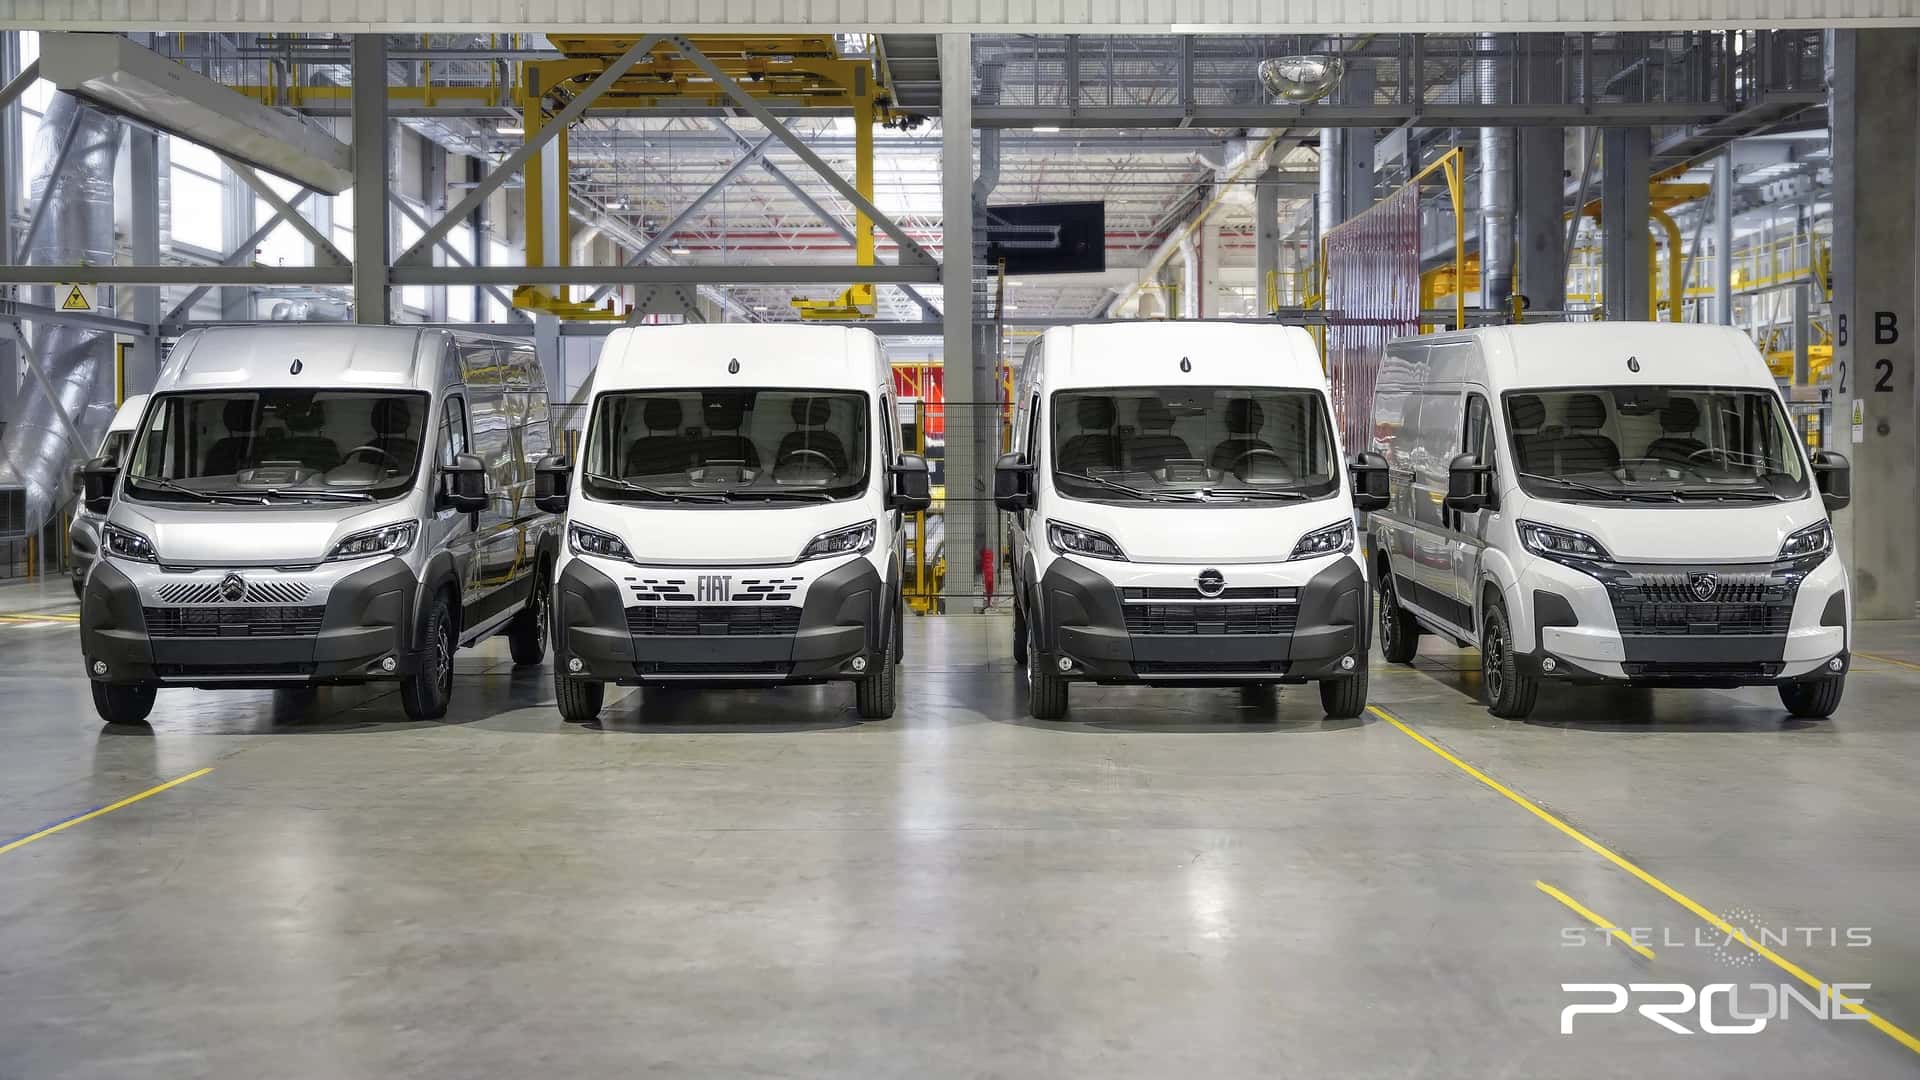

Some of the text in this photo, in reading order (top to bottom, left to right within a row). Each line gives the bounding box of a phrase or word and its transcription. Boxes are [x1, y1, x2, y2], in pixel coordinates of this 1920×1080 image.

[1838, 314, 1848, 346] B
[1875, 312, 1899, 344] B
[1839, 361, 1847, 394] 2
[1874, 359, 1894, 392] 2
[697, 575, 733, 602] FIAT
